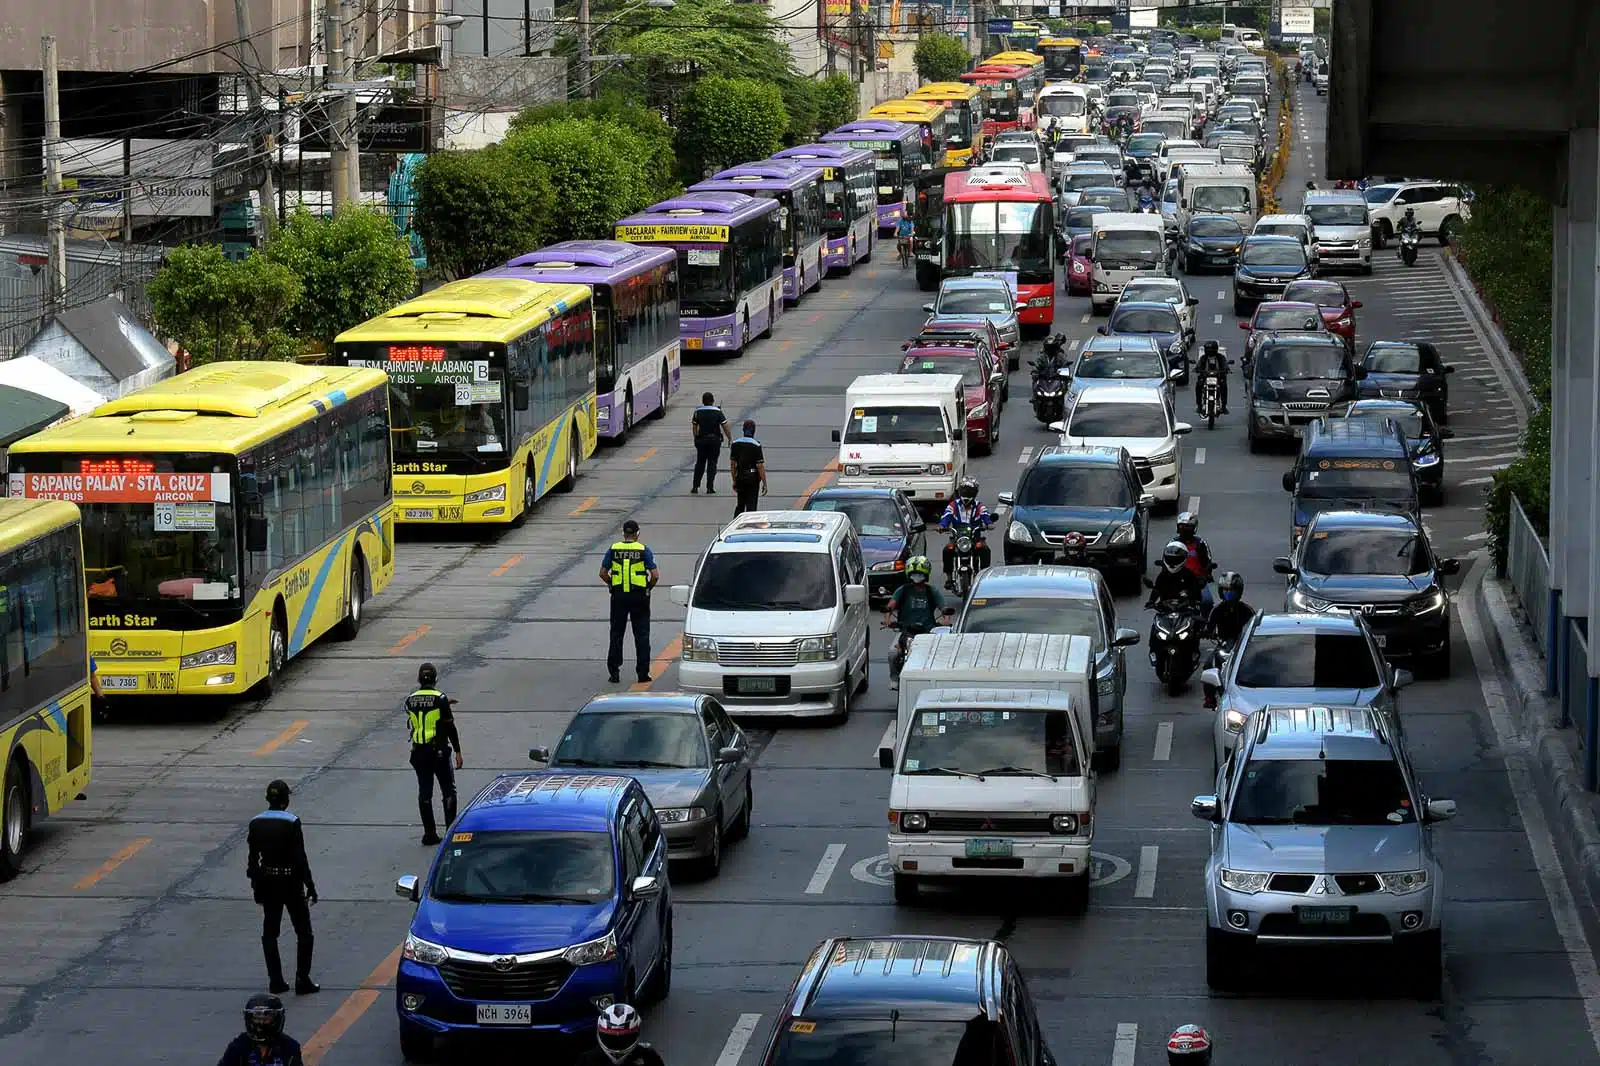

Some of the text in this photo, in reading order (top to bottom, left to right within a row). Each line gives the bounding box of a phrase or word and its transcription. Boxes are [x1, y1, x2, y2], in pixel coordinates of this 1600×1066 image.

[625, 227, 656, 236] BACLARAN
[660, 226, 688, 236] FAIRVIEW
[689, 227, 698, 235] via
[699, 226, 718, 235] AYALA
[720, 228, 726, 239] A
[388, 346, 445, 361] Earth Star
[382, 361, 424, 373] FAIRVIEW
[431, 361, 473, 373] ALABANG
[478, 365, 488, 378] B
[397, 375, 415, 384] BUS
[434, 375, 469, 384] AIRCON
[456, 391, 470, 400] 20
[81, 460, 154, 474] Earth Star
[393, 462, 447, 472] Earth Star
[31, 475, 82, 492] SAPANG
[86, 475, 126, 491] PALAY
[137, 475, 165, 491] STA.
[169, 475, 205, 491] CRUZ
[36, 492, 84, 500] CITY BUS
[155, 492, 194, 501] AIRCON
[156, 513, 172, 525] 19
[89, 614, 157, 627] arth Star
[120, 679, 137, 687] 7305
[478, 1008, 529, 1019] NCH 3964
